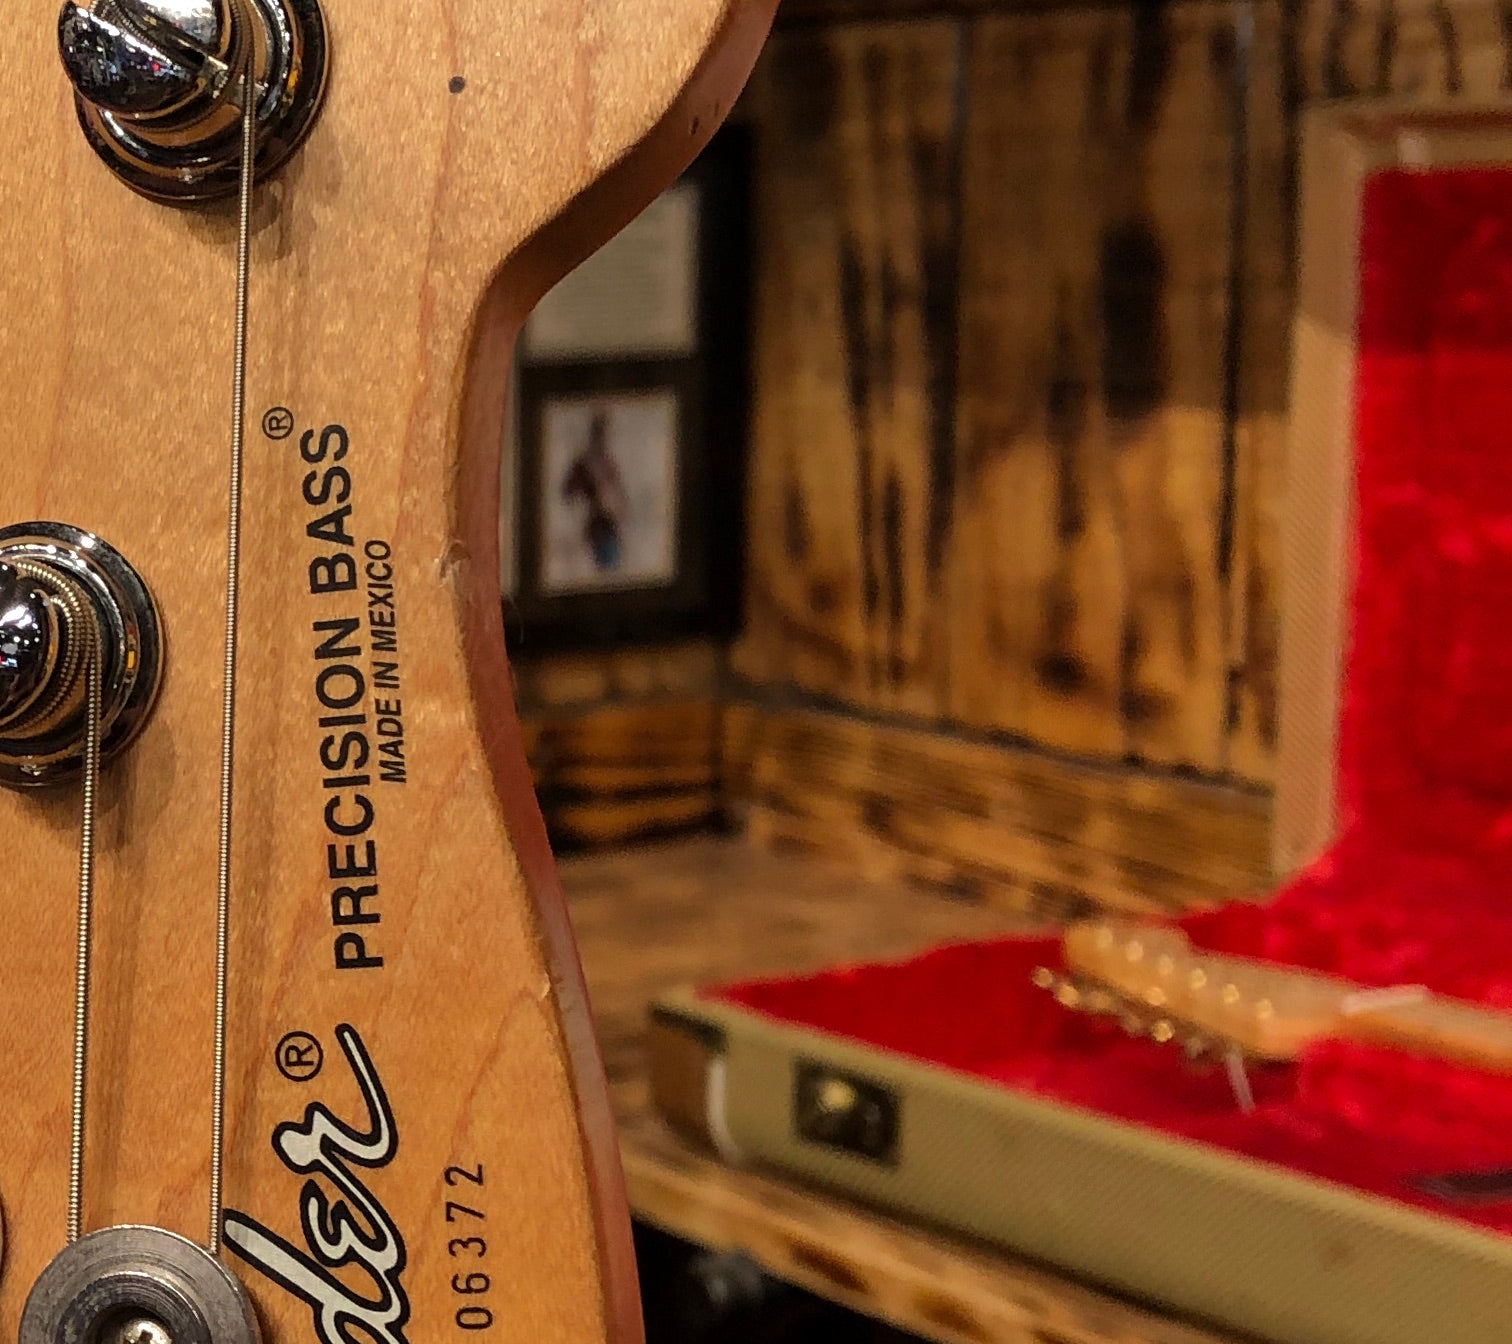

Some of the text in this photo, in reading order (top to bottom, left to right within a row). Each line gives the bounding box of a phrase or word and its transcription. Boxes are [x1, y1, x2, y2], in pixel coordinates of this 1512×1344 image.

[299, 423, 357, 594] BASS
[364, 539, 407, 784] MADE IN MEXICO
[311, 617, 384, 970] PRECISION
